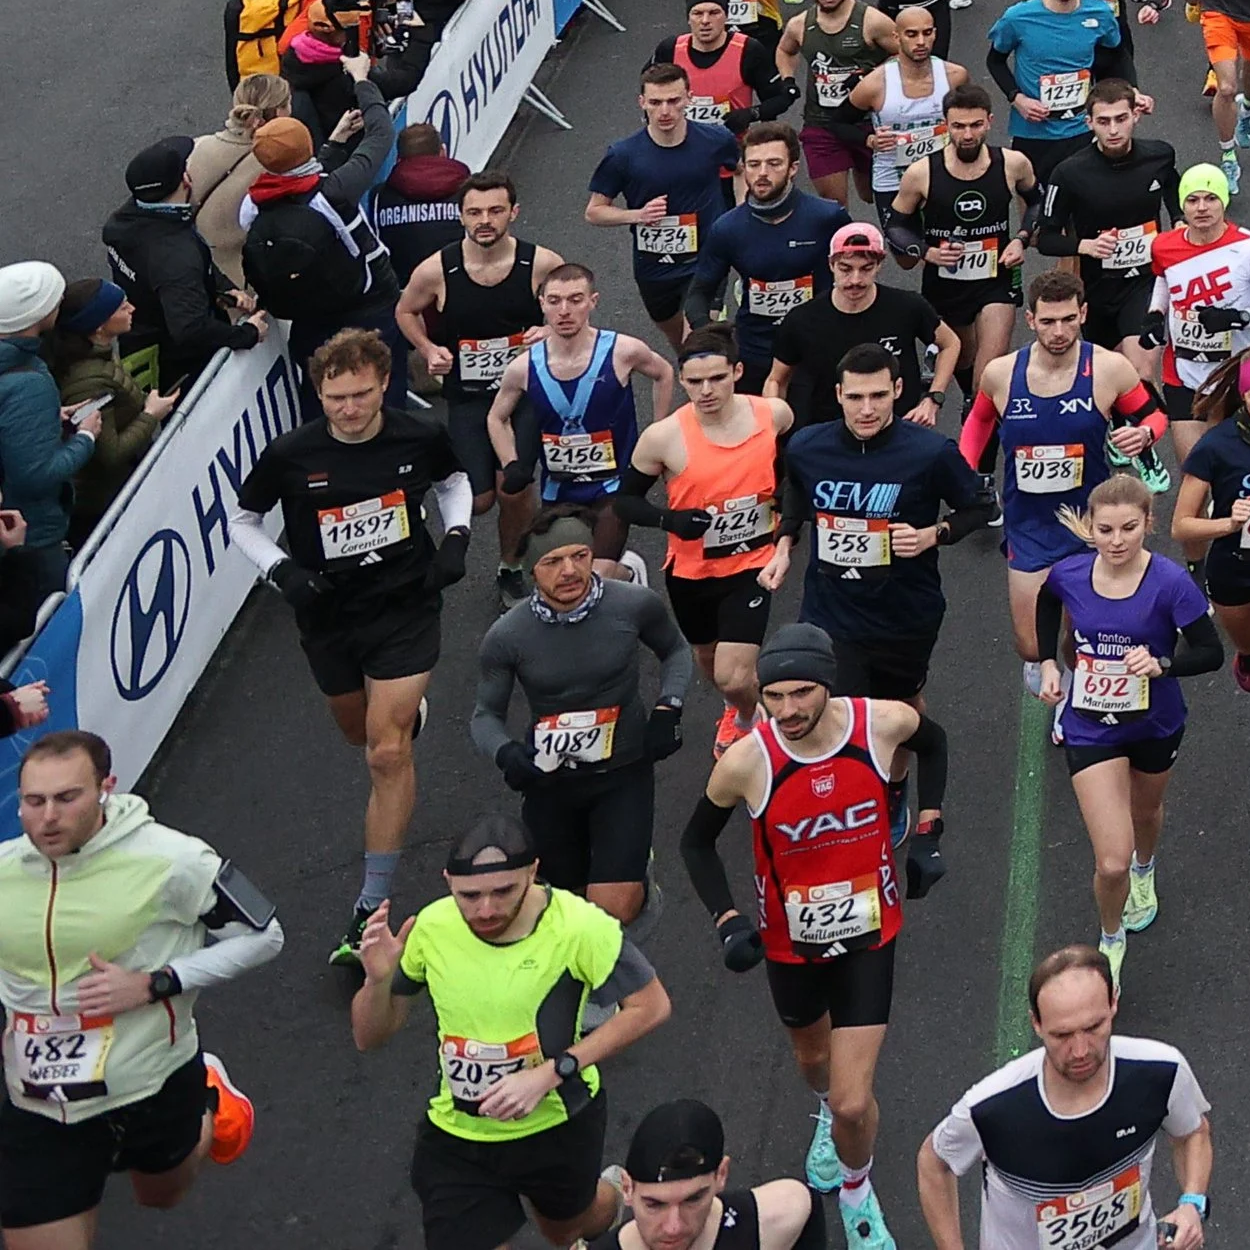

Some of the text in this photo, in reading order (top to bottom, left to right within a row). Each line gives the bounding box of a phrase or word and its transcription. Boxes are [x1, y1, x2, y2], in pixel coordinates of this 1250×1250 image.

[1044, 83, 1083, 100] 1277
[684, 107, 720, 120] 124
[906, 141, 935, 156] 608
[641, 228, 688, 244] 4734
[645, 243, 687, 253] HUGO
[958, 253, 987, 269] 110
[753, 291, 803, 306] 3548
[464, 349, 518, 369] 3385
[549, 447, 602, 463] 2156
[192, 354, 299, 577] HYUN
[1019, 461, 1072, 480] 5038
[327, 511, 396, 543] 11897
[714, 509, 759, 533] 424
[828, 533, 870, 552] 558
[832, 552, 863, 565] Lucas
[1097, 632, 1132, 644] tonton
[1084, 676, 1129, 697] 692
[1082, 697, 1131, 710] Marianne
[541, 727, 601, 754] 1089
[776, 799, 878, 843] YAC
[799, 898, 859, 928] 432
[800, 925, 862, 943] Guillaume
[24, 1035, 87, 1063] 482
[29, 1064, 80, 1080] WEBER
[1045, 1193, 1127, 1246] 3568
